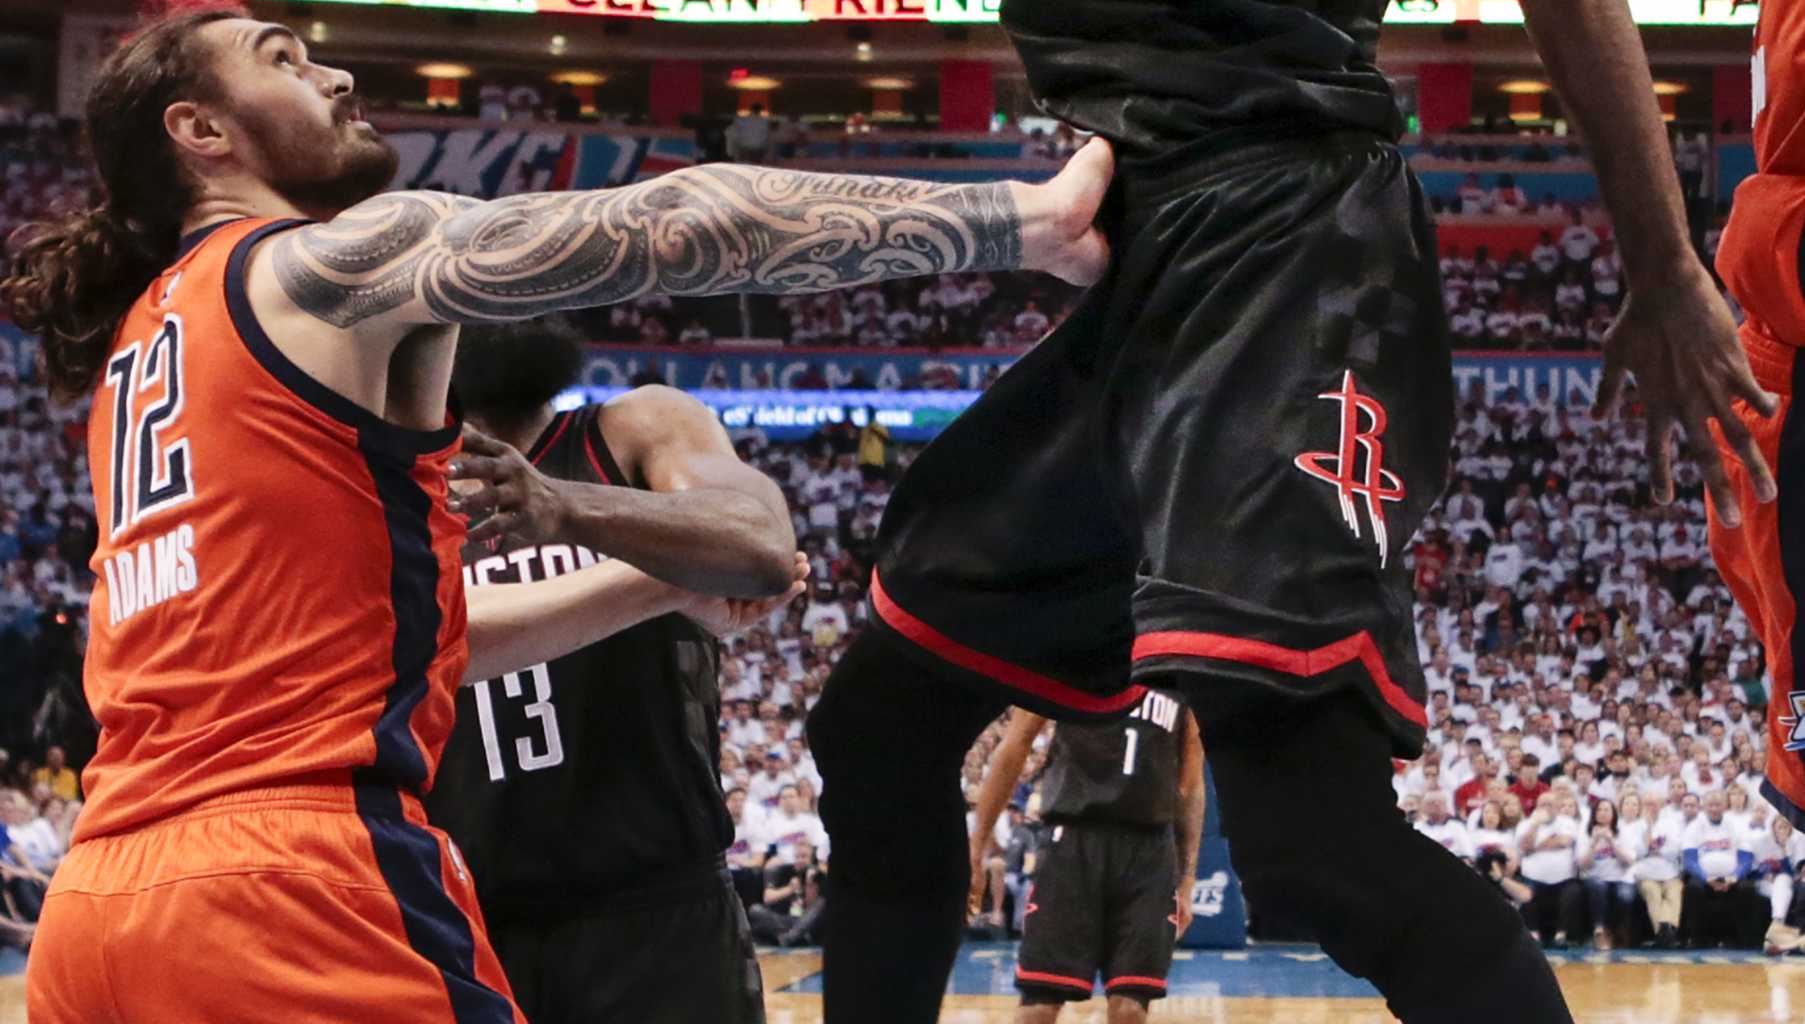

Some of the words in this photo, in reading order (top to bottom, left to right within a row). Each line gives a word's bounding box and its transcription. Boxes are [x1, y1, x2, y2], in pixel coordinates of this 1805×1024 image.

[1451, 366, 1602, 409] THUN
[105, 312, 195, 543] 12
[104, 523, 198, 626] ADAMS
[474, 662, 564, 781] 13
[1130, 690, 1180, 733] TON
[1122, 728, 1138, 775] 1
